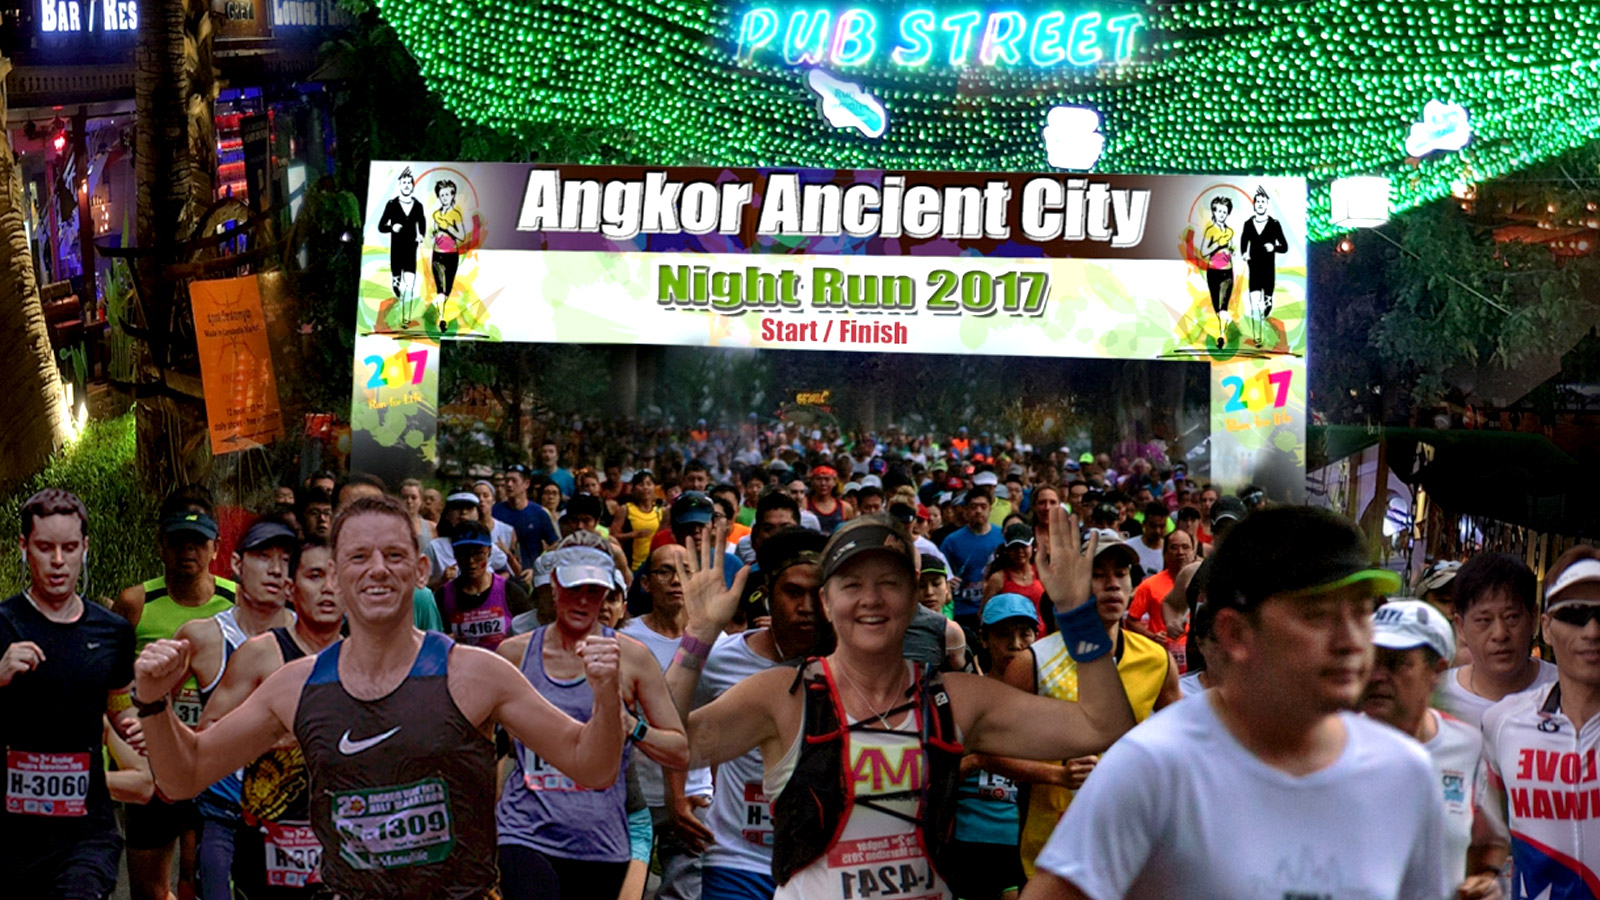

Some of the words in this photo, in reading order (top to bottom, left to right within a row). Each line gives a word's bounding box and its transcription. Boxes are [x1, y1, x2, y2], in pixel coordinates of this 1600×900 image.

[738, 8, 876, 66] PUB
[892, 11, 1144, 66] STREET
[516, 169, 753, 240] Angkor
[758, 172, 1011, 239] Ancient
[1021, 176, 1151, 248] City
[657, 265, 802, 316] Night
[811, 267, 916, 311] Run
[926, 269, 1049, 317] 2017
[761, 318, 818, 342] Start
[840, 320, 908, 344] Finish
[363, 348, 429, 389] 2017
[1221, 367, 1293, 413] 2017
[11, 772, 87, 797] H-3060
